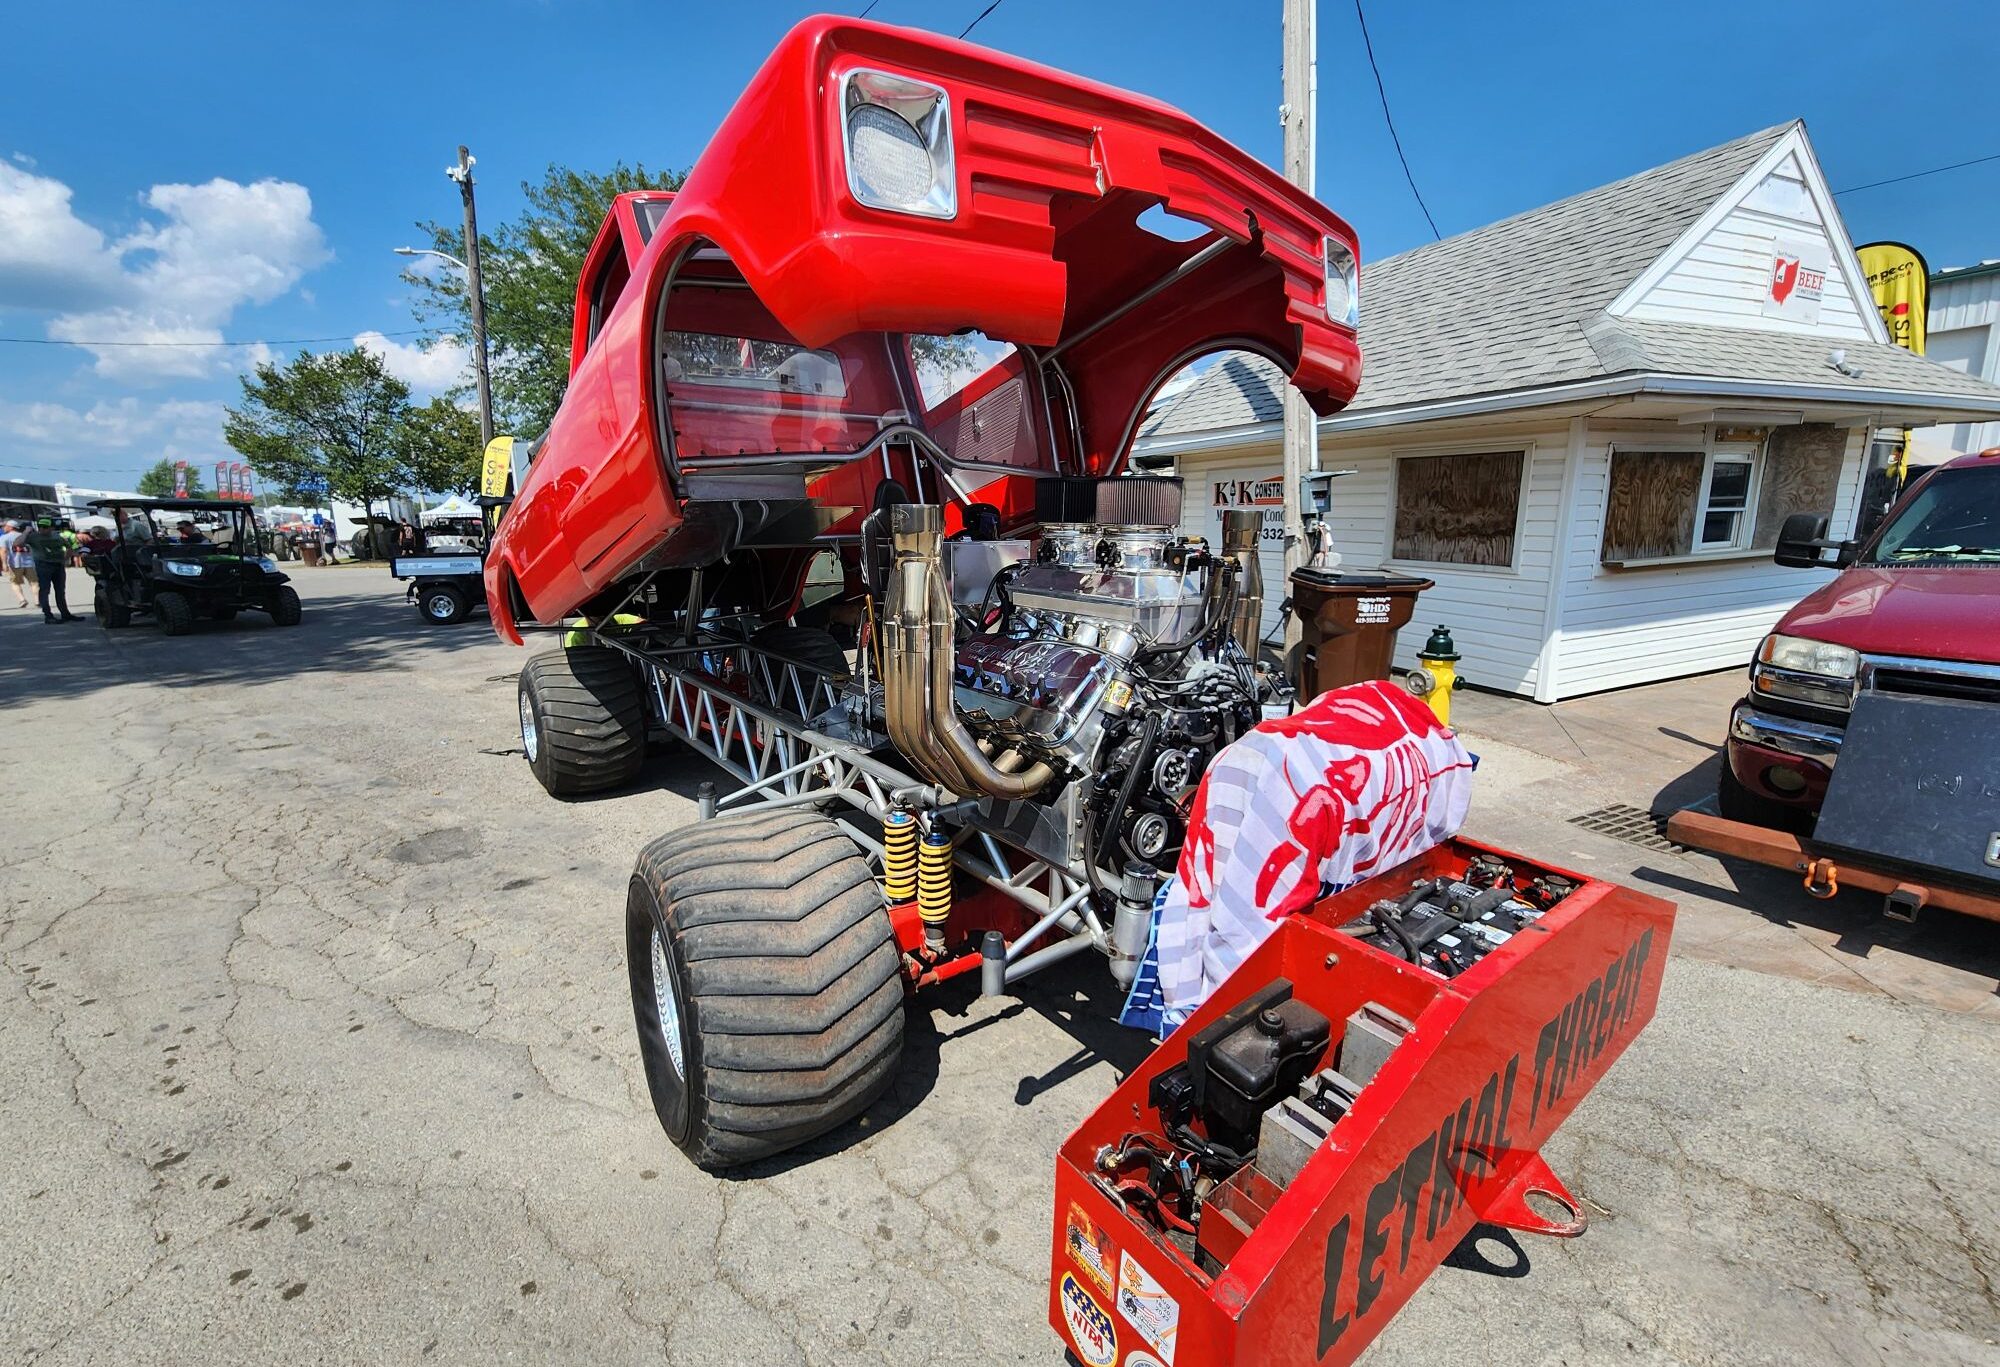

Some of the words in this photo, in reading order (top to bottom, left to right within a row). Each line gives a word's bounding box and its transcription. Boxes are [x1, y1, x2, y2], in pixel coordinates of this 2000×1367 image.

[1213, 482, 1229, 506] K
[1237, 481, 1254, 506] K
[1370, 603, 1391, 613] HDS
[1316, 1053, 1520, 1362] LETHAL
[1529, 925, 1655, 1132] THREAT
[1072, 1310, 1104, 1356] NTPA
